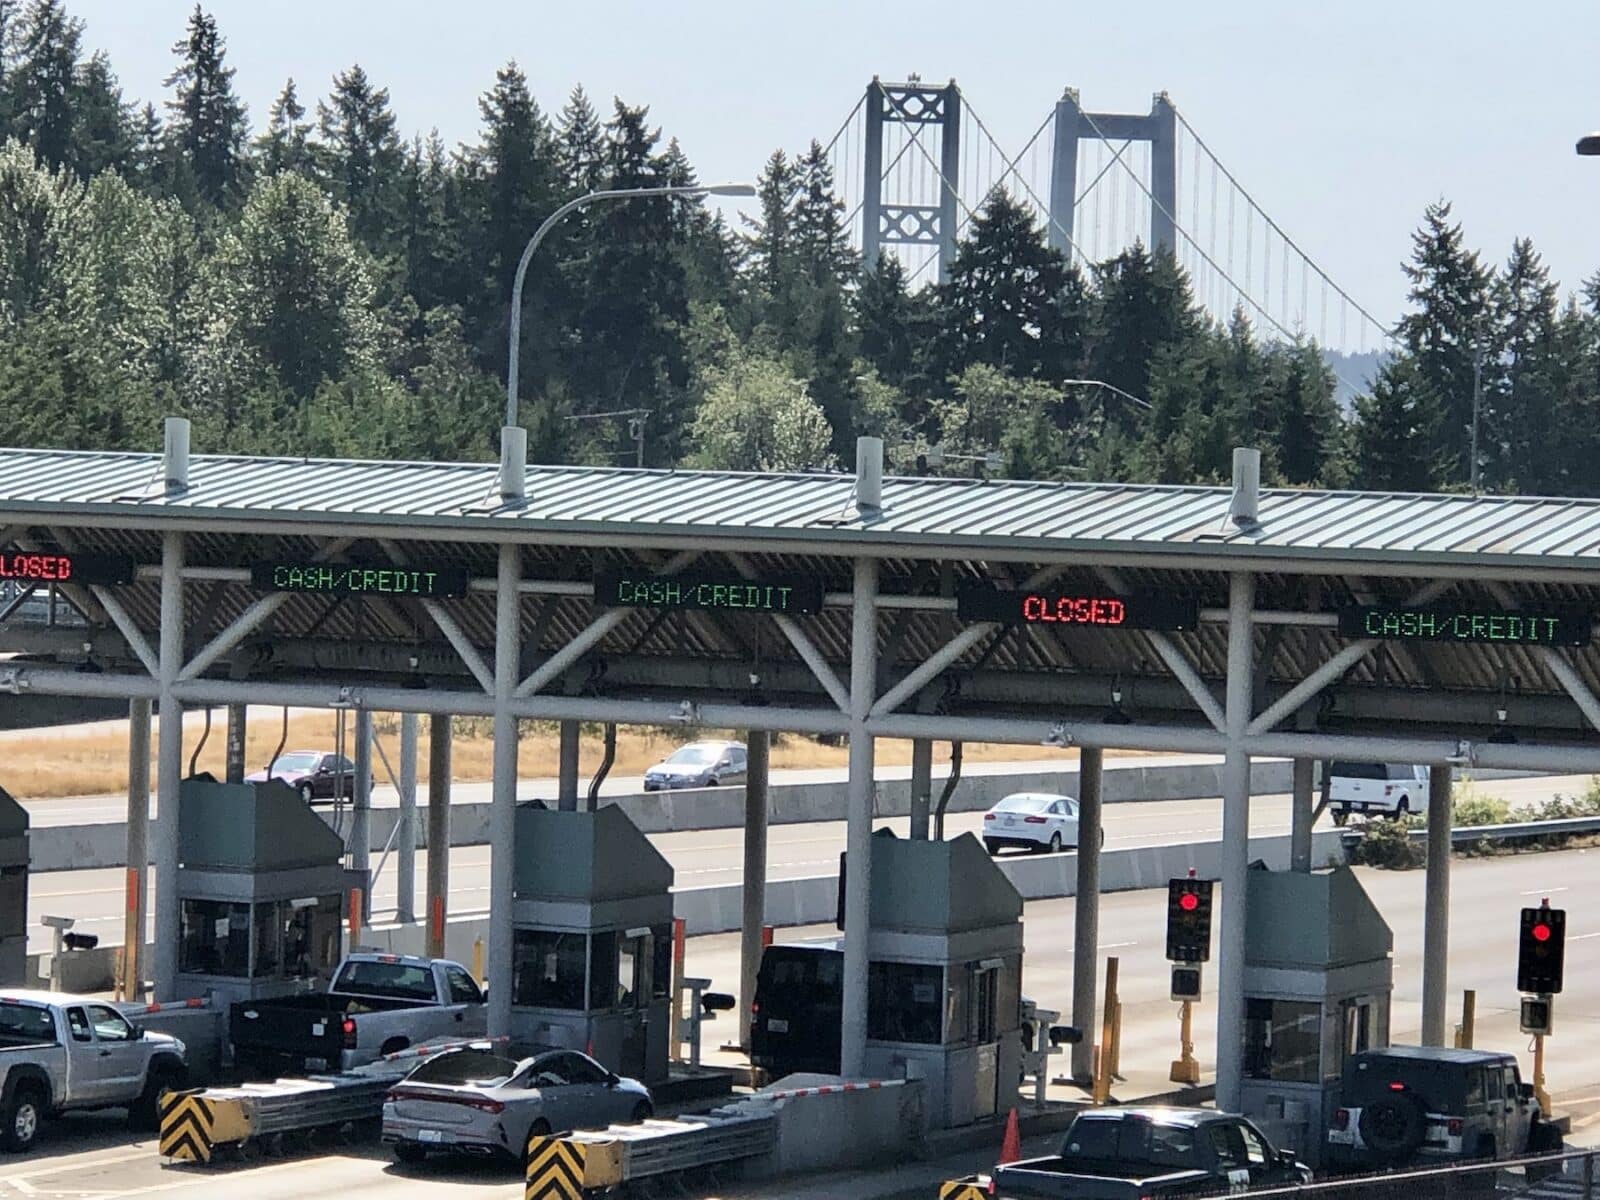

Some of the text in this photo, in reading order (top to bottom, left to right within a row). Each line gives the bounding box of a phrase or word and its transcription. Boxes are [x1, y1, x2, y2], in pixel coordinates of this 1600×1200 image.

[0, 555, 71, 579] LOSED
[273, 566, 437, 593] CASH/CREDIT
[618, 580, 793, 608] CASH/CREDIT
[1023, 595, 1125, 624] CLOSED
[1365, 611, 1560, 640] CASH/CREDIT
